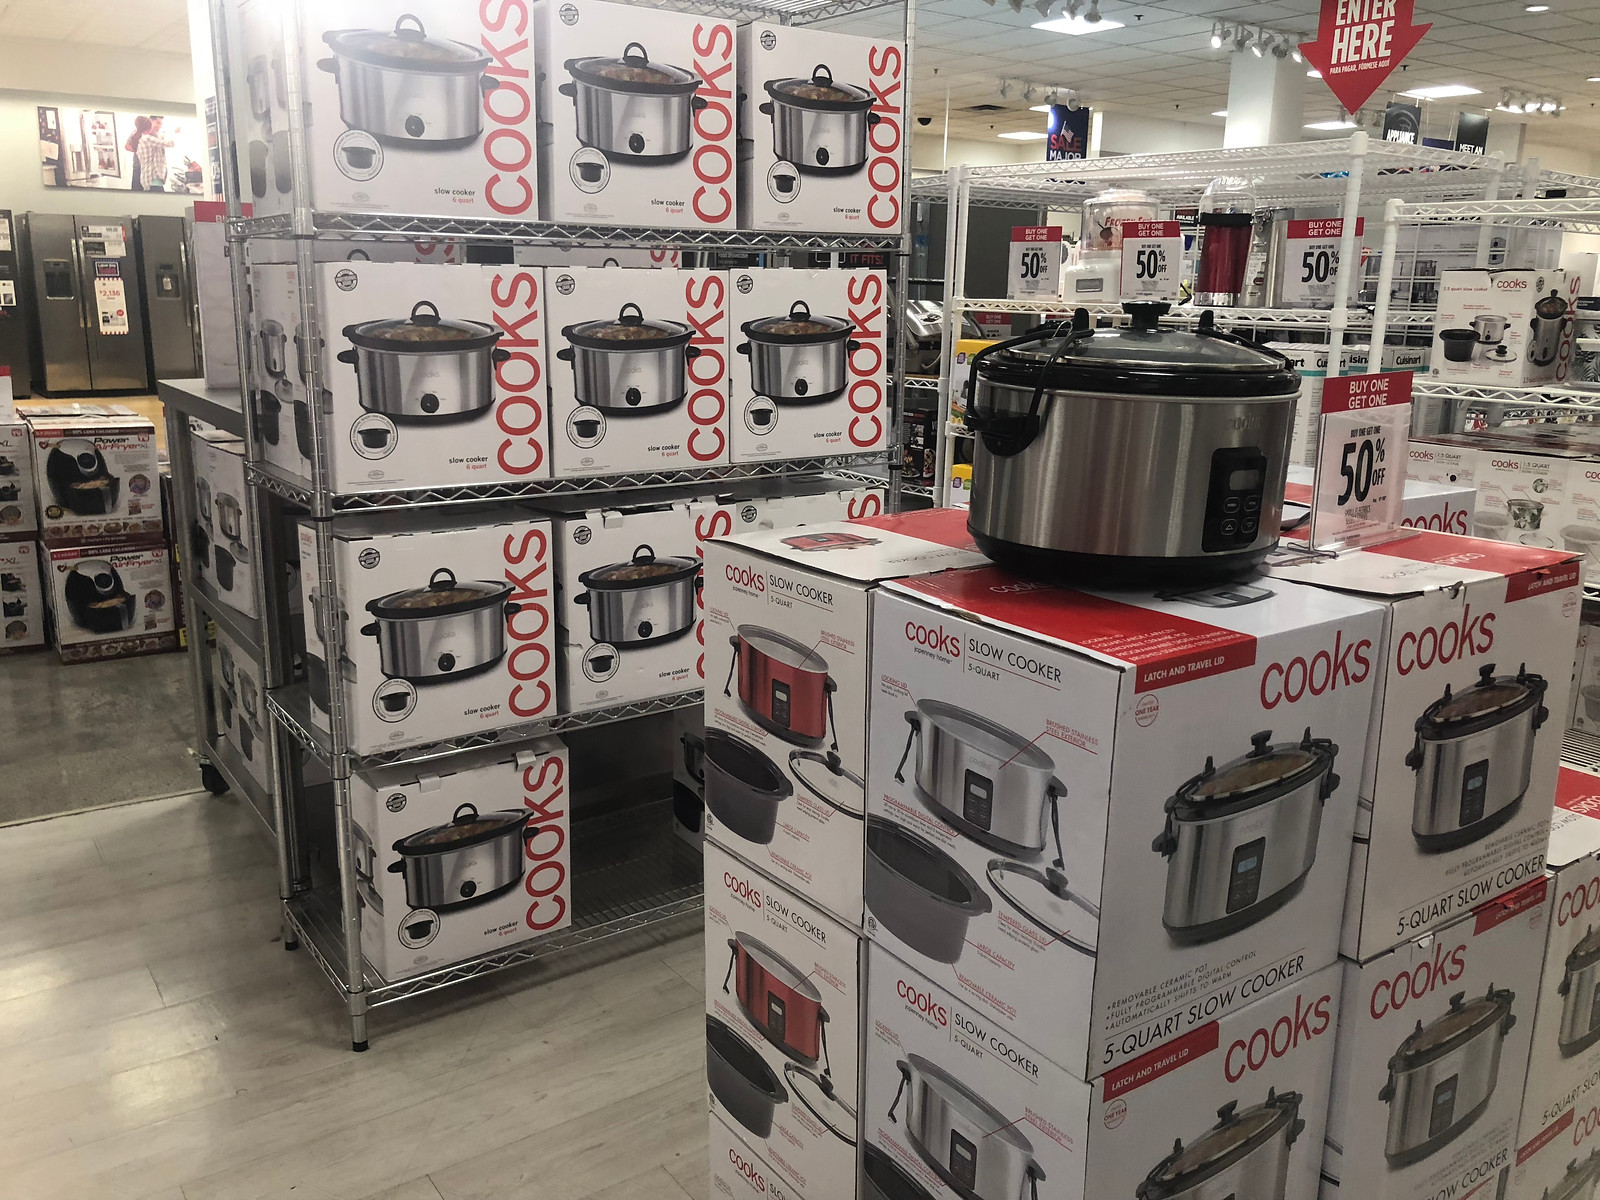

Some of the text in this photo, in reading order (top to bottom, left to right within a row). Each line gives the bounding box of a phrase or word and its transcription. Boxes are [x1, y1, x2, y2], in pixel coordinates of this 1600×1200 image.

[1335, 0, 1397, 26] ENTER
[1331, 19, 1395, 64] HERE
[1330, 66, 1341, 74] PARA
[1342, 64, 1357, 73] PAGAR,
[479, 0, 534, 216] COOKS
[692, 23, 733, 224] COOKS
[867, 45, 902, 229] COOKS
[1050, 134, 1082, 152] SALE
[1386, 129, 1415, 145] APPLIANCE
[1050, 150, 1082, 161] MAJOR
[1459, 144, 1484, 155] MEET AN
[434, 187, 476, 197] slow cooker
[458, 197, 475, 205] quart
[651, 199, 685, 207] slow cooker
[670, 207, 684, 215] quart
[1308, 221, 1324, 229] BUY
[1308, 227, 1341, 236] GET ONE
[861, 254, 884, 265] FITS!
[1158, 265, 1167, 273] OFF
[1329, 266, 1338, 276] OF
[1497, 278, 1527, 289] cooks
[1555, 276, 1581, 382] COOKS
[685, 275, 726, 461] COOKS
[847, 274, 883, 447] COOKS
[1396, 355, 1421, 366] Cuisinart
[490, 272, 544, 475] COOKS
[1349, 378, 1389, 394] BUY ONE
[1348, 393, 1387, 409] GET ONE
[1350, 429, 1358, 438] BUY
[1373, 425, 1381, 435] ONE
[647, 444, 680, 453] slow cooker
[666, 451, 679, 459] quart
[1409, 450, 1434, 460] cooks
[449, 455, 488, 464] slow cooker
[471, 463, 487, 471] quart
[1491, 459, 1519, 470] cooks
[1372, 468, 1386, 486] OFF
[110, 554, 143, 562] Power
[725, 564, 834, 606] cooks SLOW COOKER
[771, 596, 793, 609] 5-QUART
[503, 528, 551, 717] COOKS
[1396, 603, 1497, 676] cooks
[905, 621, 1062, 684] cooks SLOW COOKER
[913, 646, 935, 660] jcpenney
[673, 667, 690, 675] cooker
[676, 673, 689, 681] quart
[967, 663, 1000, 682] 5-QUART
[1144, 656, 1225, 683] LATCH AND TRAVEL LID
[1260, 630, 1372, 710] cooks
[464, 703, 501, 716] slow cooker
[485, 710, 500, 719] quart
[1135, 704, 1159, 716] ONE YEAR
[1045, 726, 1086, 747] STEEL EXTERIOR
[1046, 719, 1098, 746] BRUSHED STAINLESS
[523, 756, 566, 931] COOKS
[1396, 894, 1453, 936] 5-QUART
[1457, 876, 1493, 908] SLOW
[1496, 854, 1545, 889] COOKER
[723, 871, 826, 943] cooks SLOW COOKER
[484, 920, 519, 936] slow cooker
[1022, 925, 1038, 940] GLASS
[977, 942, 992, 955] LARGE
[992, 951, 1015, 969] CAPACITY
[1110, 951, 1257, 1020] FULLY PROGRAMMABLE DIGITAL CONTROL
[1112, 963, 1208, 1009] REMOVABLE CERAMIC POT
[1370, 943, 1467, 1020] cooks
[985, 991, 1006, 1009] CERAMIC
[1109, 971, 1232, 1030] AUTOMATICALLY SHIFTS TO WARM
[1103, 955, 1305, 1065] 5-QUART SLOW COOKER
[897, 979, 947, 1027] cooks
[954, 1013, 987, 1042] SLOW
[990, 1037, 1039, 1078] COOKER
[954, 1035, 984, 1060] 5-QUART
[1224, 994, 1332, 1084] cooks
[1112, 1048, 1189, 1092] LATCH AND TRAVEL LID
[1103, 1105, 1127, 1121] ONE YEAR
[1541, 1086, 1582, 1125] 5-QUART
[729, 1148, 766, 1192] cooks
[1461, 1148, 1508, 1188] COOKER
